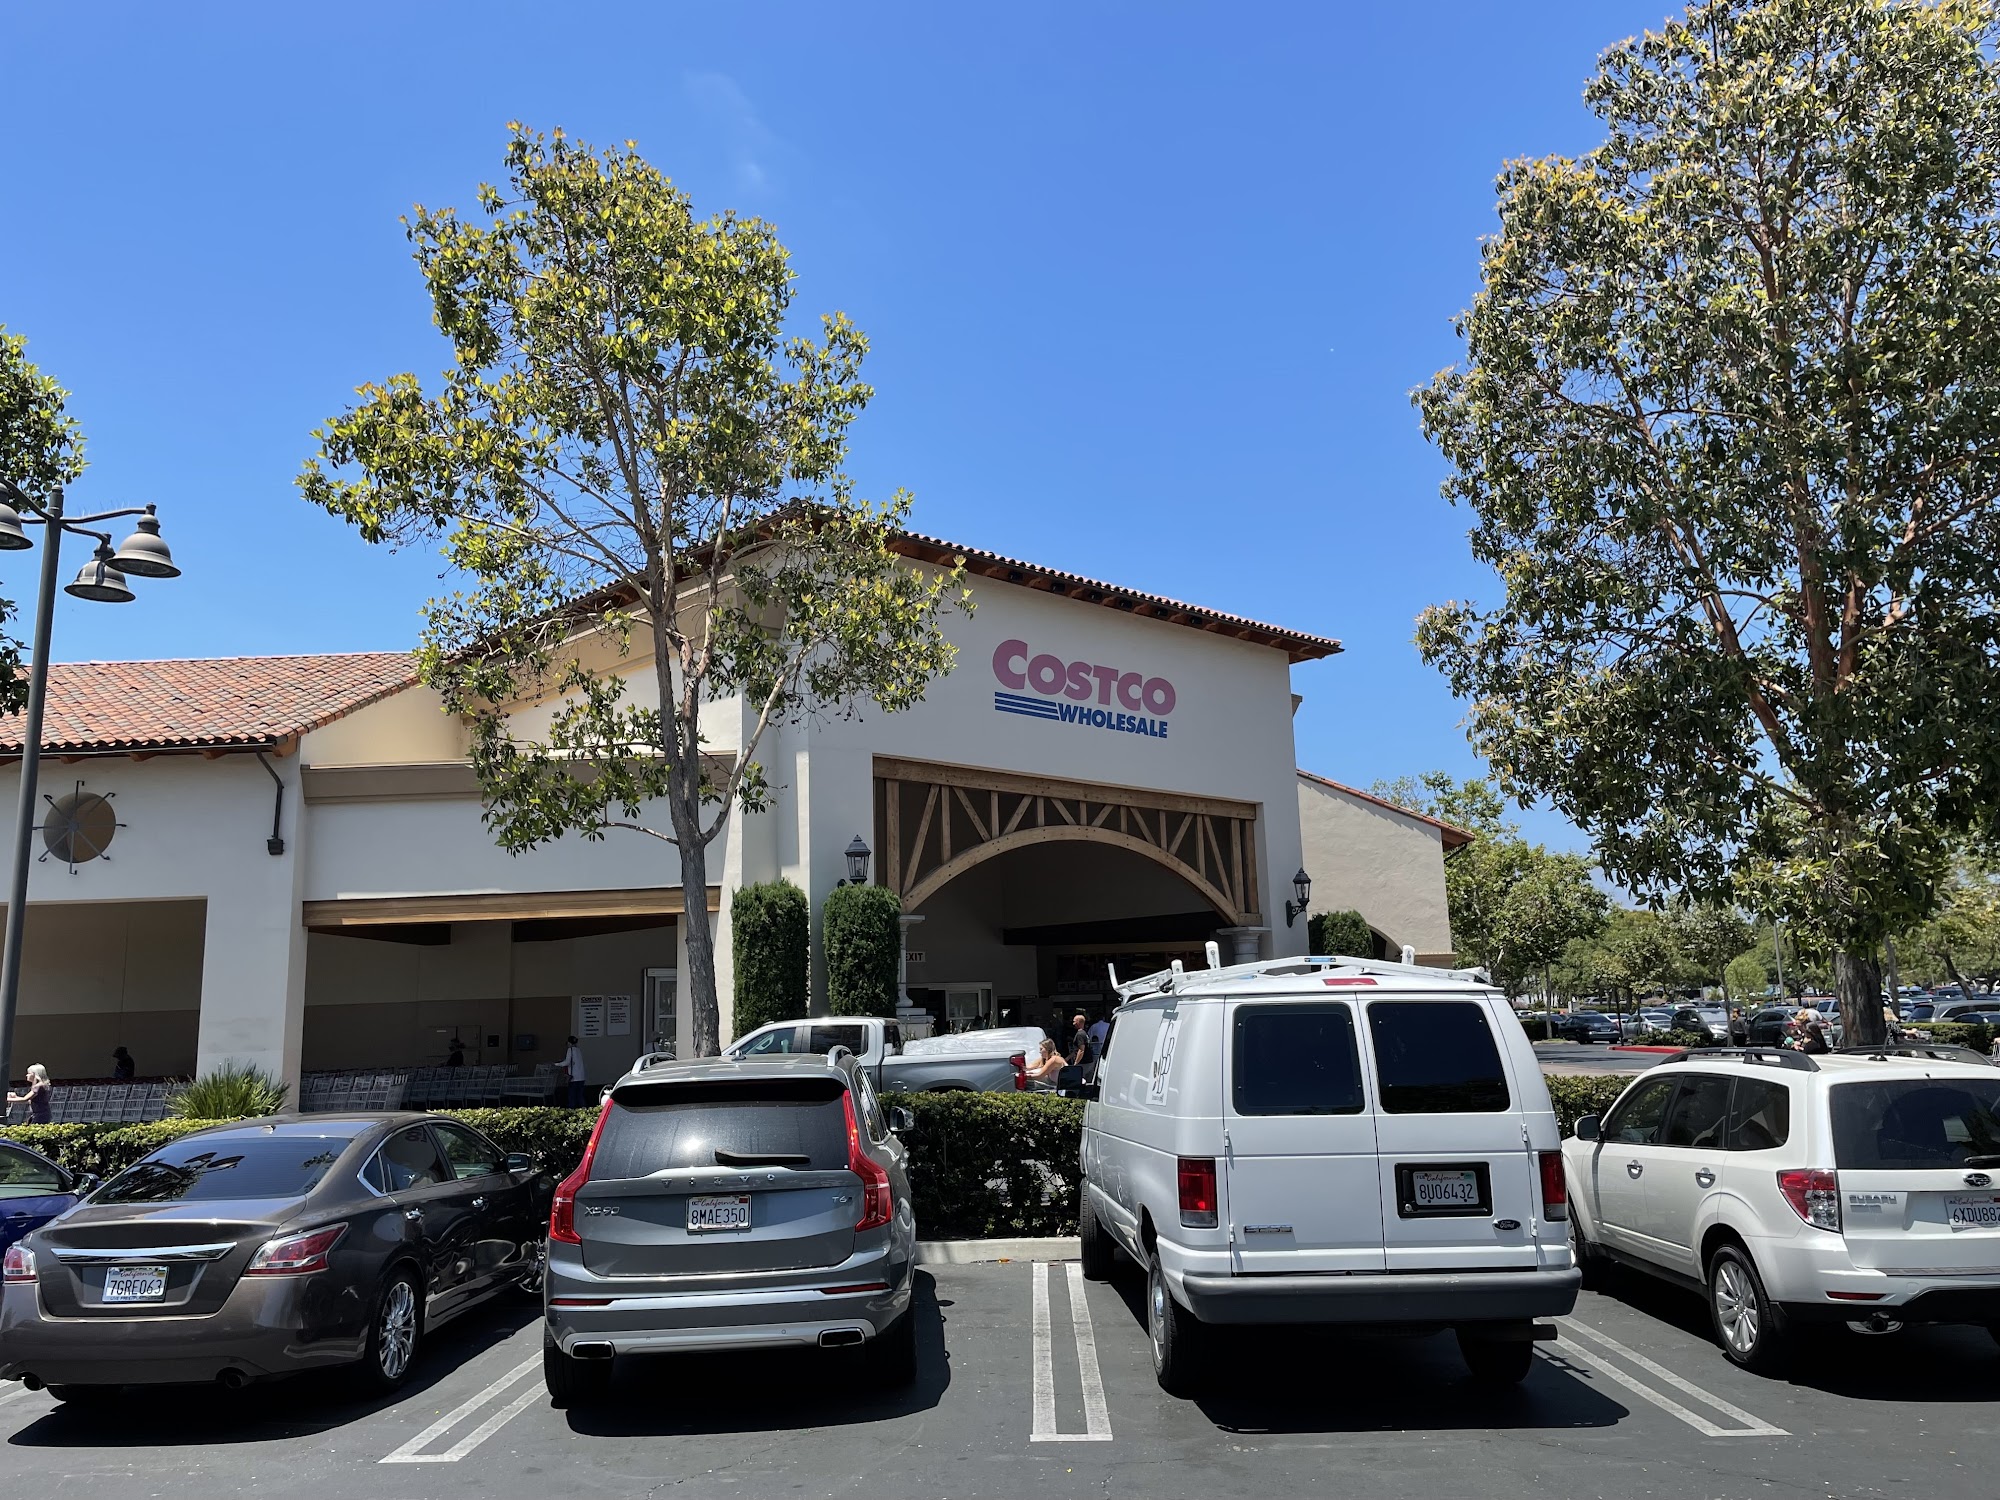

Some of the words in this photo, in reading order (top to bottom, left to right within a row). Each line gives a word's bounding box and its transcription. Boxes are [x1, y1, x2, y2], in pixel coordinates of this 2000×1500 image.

[992, 639, 1176, 716] COSTCO
[1058, 703, 1168, 739] WHOLESALE
[1426, 1172, 1464, 1183] California
[1419, 1183, 1474, 1199] 8U06432
[701, 1198, 739, 1208] California
[691, 1208, 746, 1225] 8MAE350
[120, 1270, 156, 1279] California
[110, 1279, 163, 1296] 7GRE063
